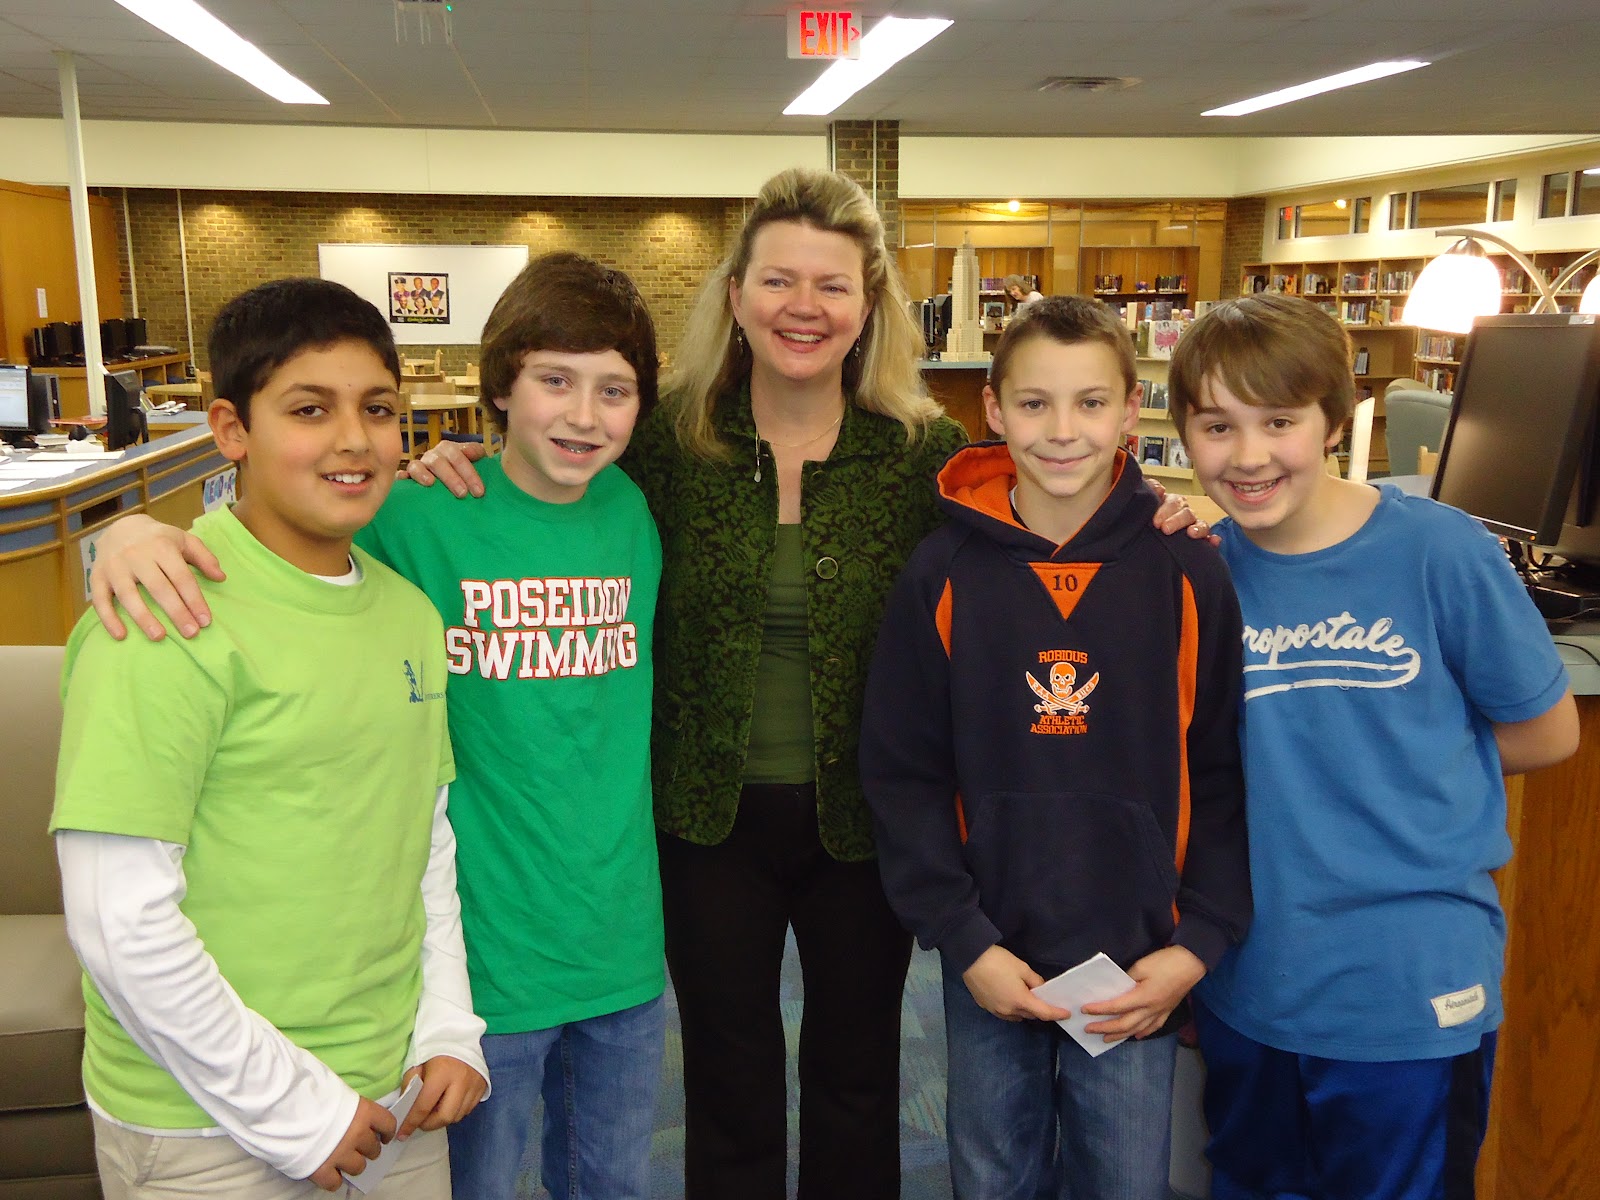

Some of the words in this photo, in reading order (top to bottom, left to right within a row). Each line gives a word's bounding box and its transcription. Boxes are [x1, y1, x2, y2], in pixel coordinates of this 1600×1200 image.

[800, 11, 852, 55] EXIT
[1052, 574, 1078, 592] 10
[460, 577, 631, 628] POSEIDON
[1030, 722, 1088, 735] ASSOCIATION
[1039, 715, 1085, 725] ATHLETIC
